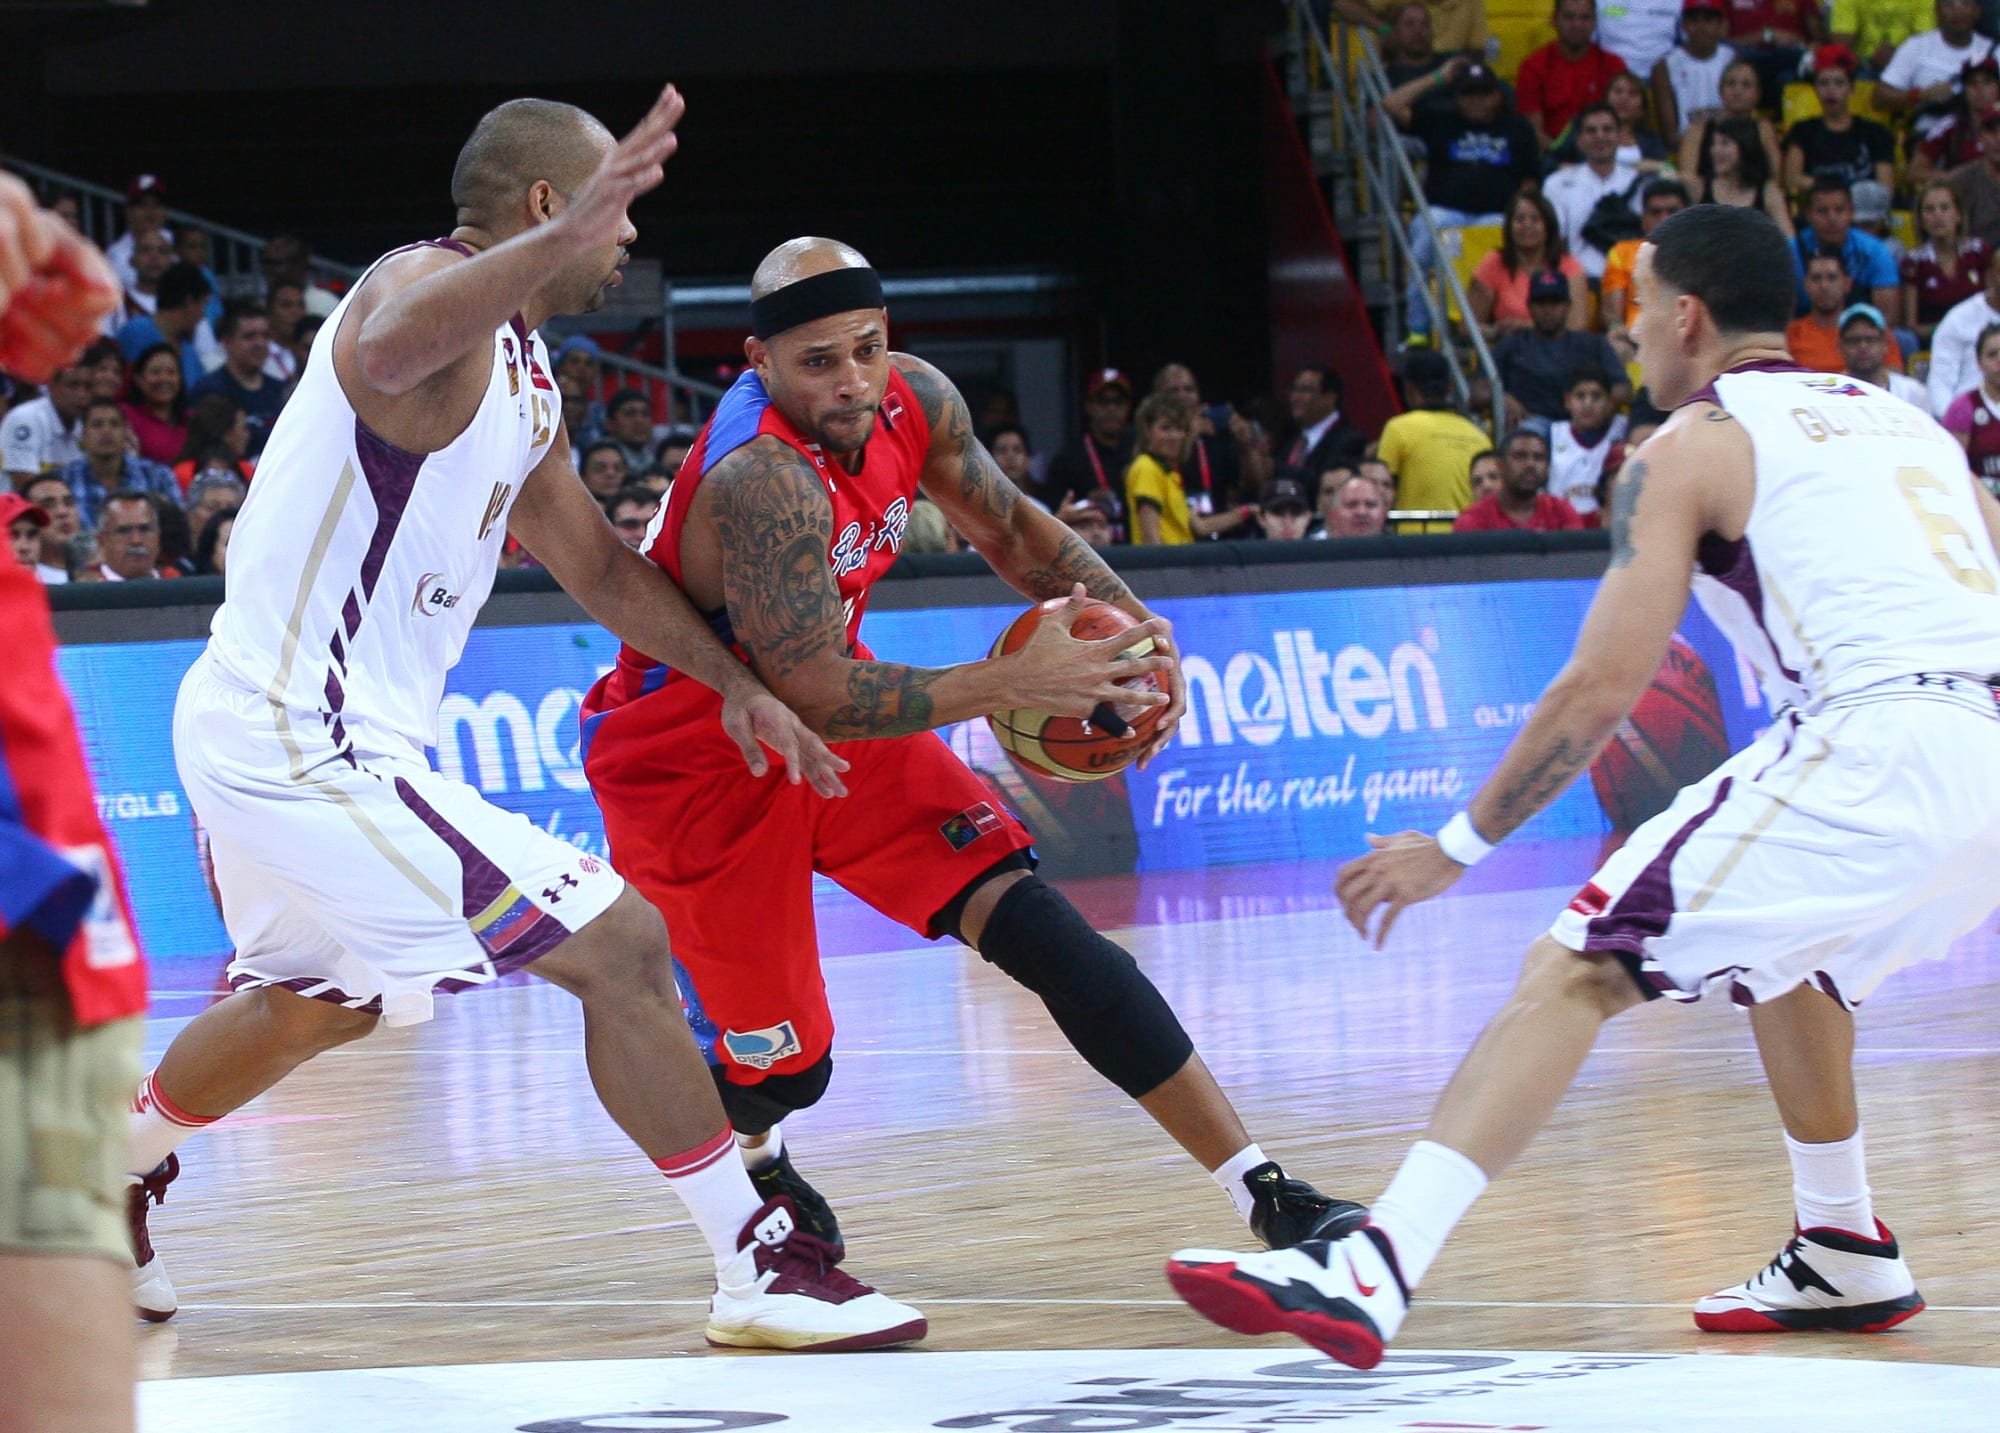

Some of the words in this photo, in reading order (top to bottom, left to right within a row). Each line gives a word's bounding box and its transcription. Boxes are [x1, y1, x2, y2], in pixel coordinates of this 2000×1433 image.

[1896, 466, 1997, 595] 6
[1153, 769, 1212, 826] For
[1217, 762, 1276, 814] the
[1281, 754, 1356, 810] real
[1362, 767, 1463, 824] game
